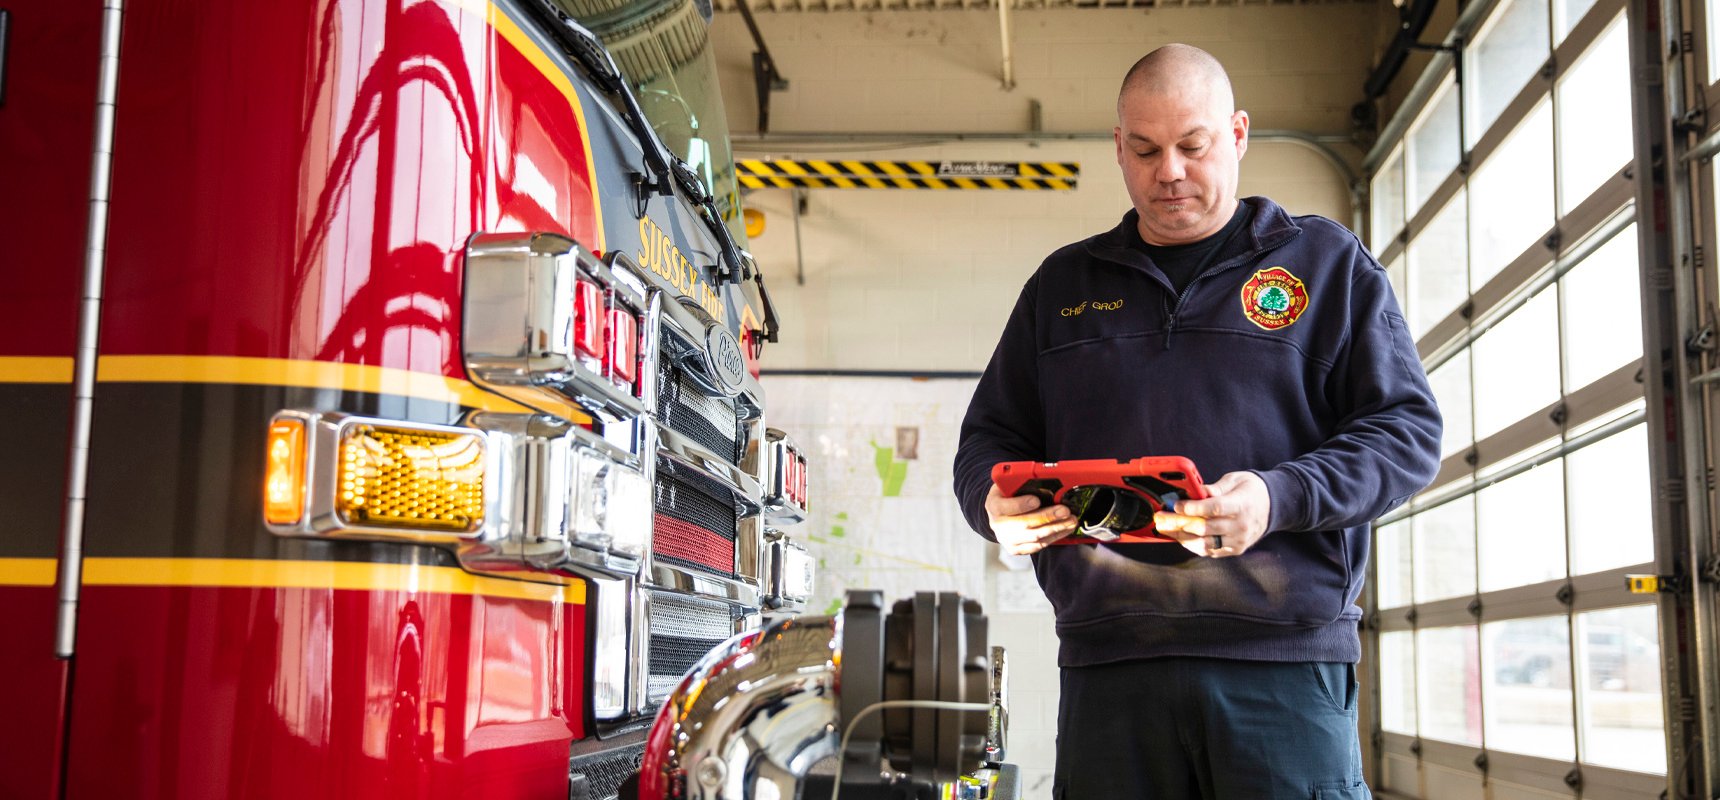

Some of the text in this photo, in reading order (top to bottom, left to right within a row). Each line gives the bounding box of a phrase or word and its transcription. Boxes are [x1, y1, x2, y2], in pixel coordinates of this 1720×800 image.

[638, 215, 724, 323] SUSSEX FIRE
[1061, 299, 1124, 317] CHIEF GROD
[1255, 316, 1284, 325] SUSSEX
[718, 332, 741, 379] Pierce
